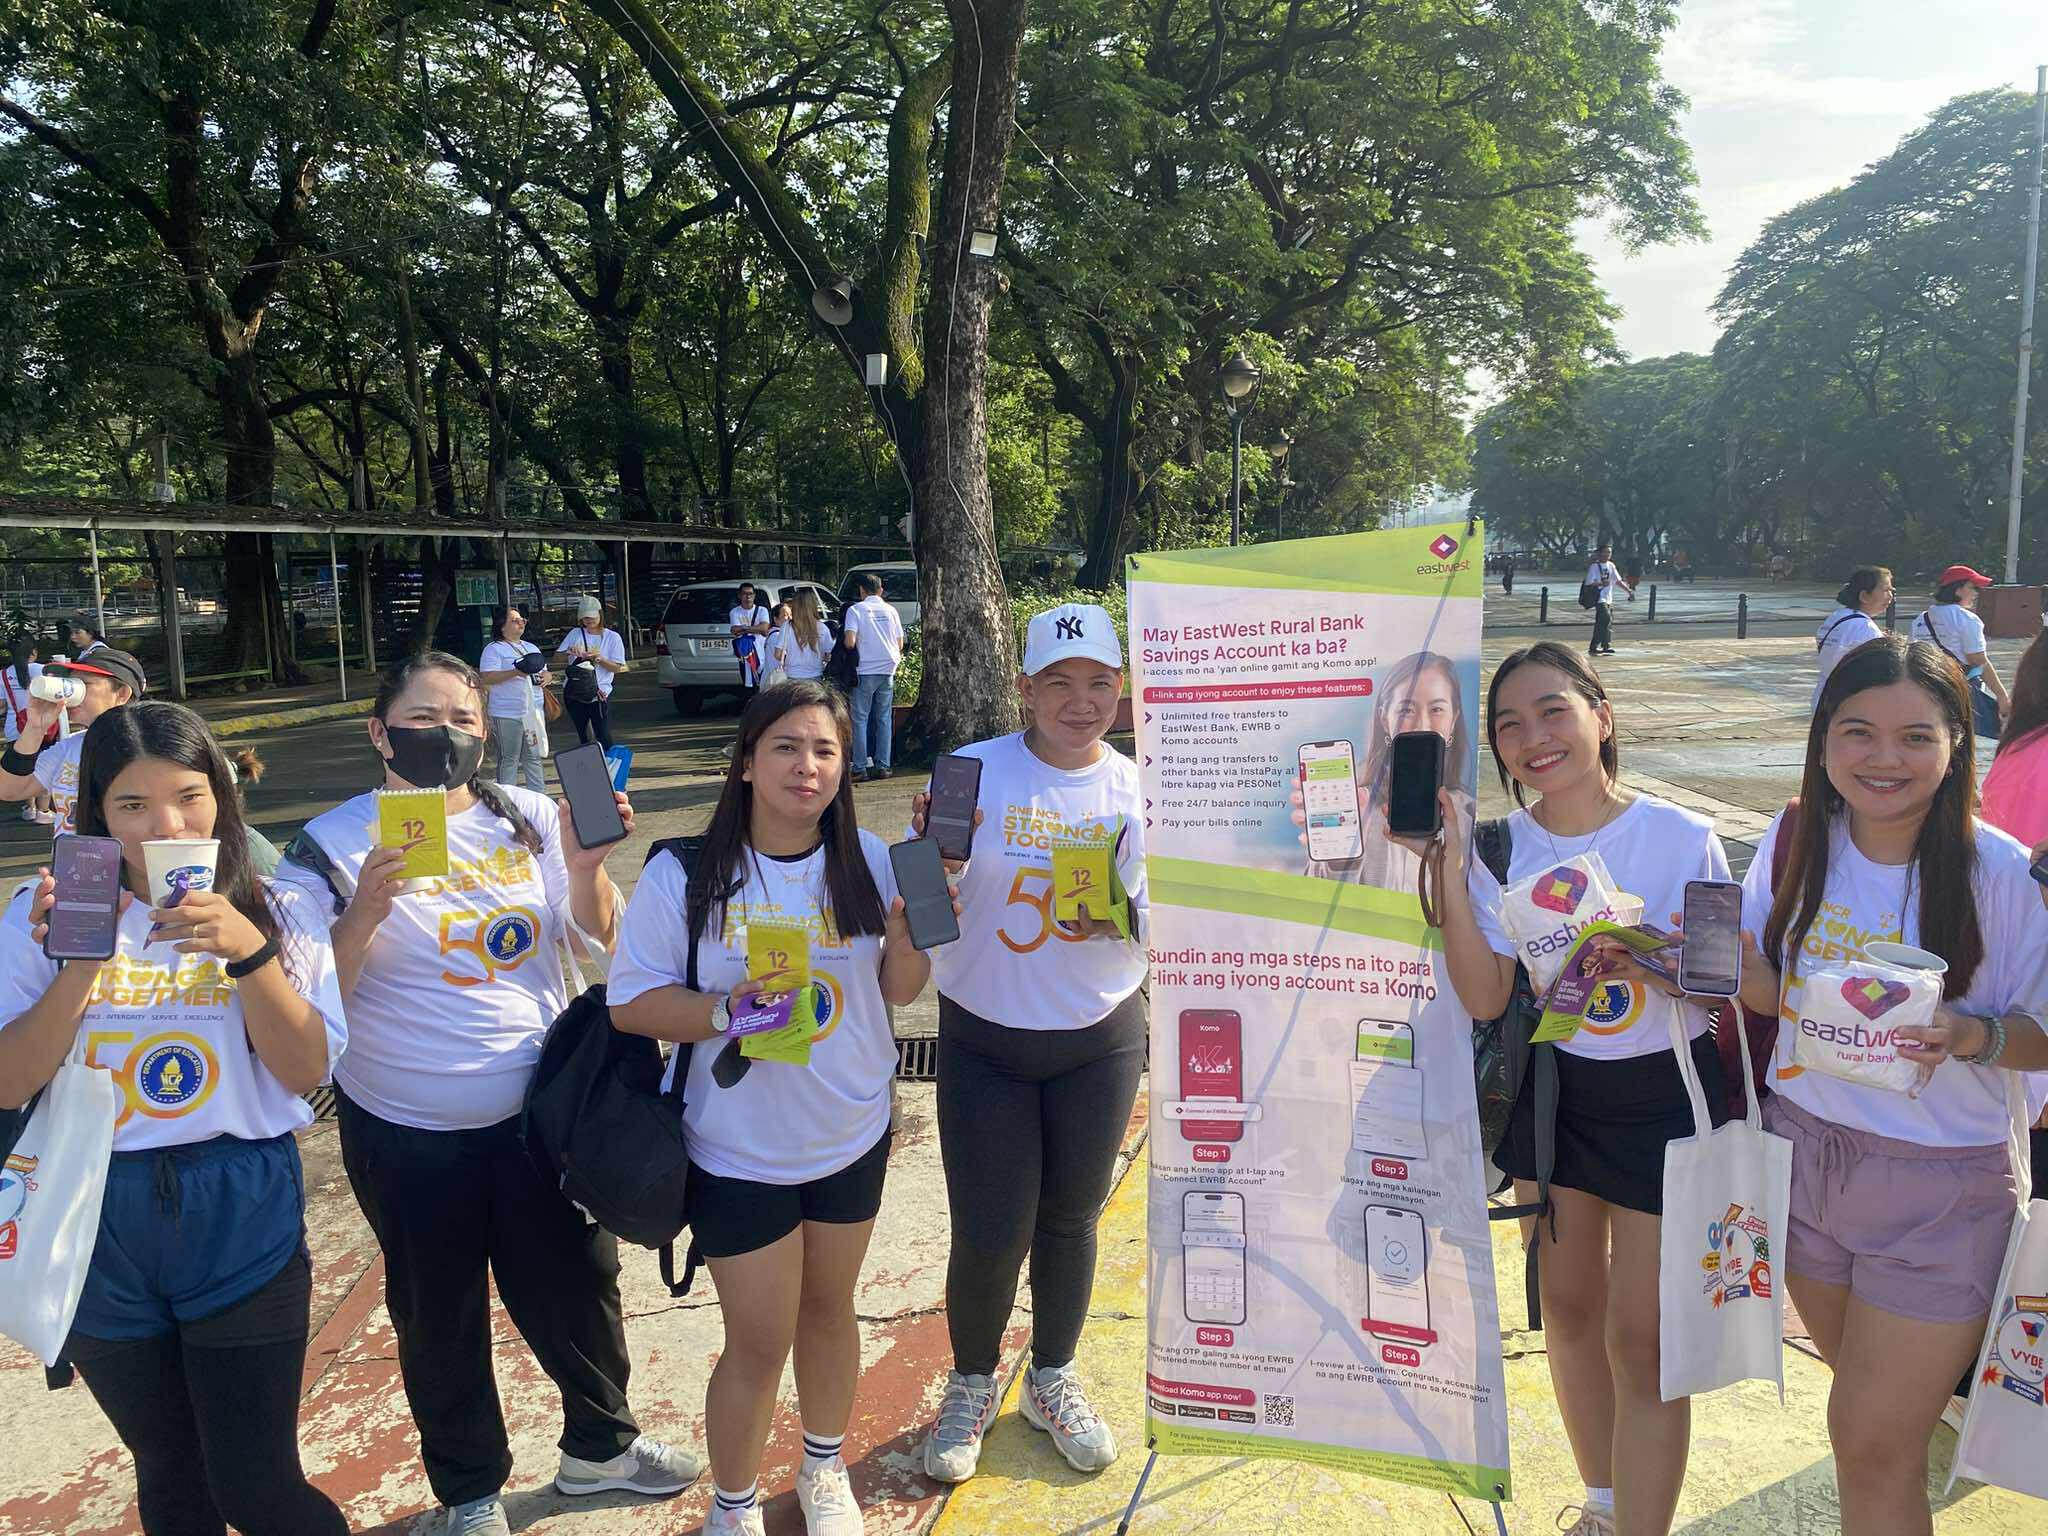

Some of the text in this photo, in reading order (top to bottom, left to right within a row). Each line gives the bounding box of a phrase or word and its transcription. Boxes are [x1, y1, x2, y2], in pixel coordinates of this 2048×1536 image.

[1416, 560, 1471, 575] eastwest
[1055, 616, 1084, 640] NY
[1143, 614, 1364, 644] May EastWest Rural Bank
[1143, 638, 1347, 665] Savings Account ka ba?
[1143, 668, 1183, 676] I-access
[1186, 667, 1200, 675] mo
[1203, 667, 1215, 675] na
[1240, 663, 1269, 673] online
[1271, 661, 1298, 672] gamit
[1301, 661, 1320, 670] ang
[1322, 659, 1351, 668] Komo
[1354, 657, 1377, 668] app!
[1152, 683, 1366, 700] I-link ang iyong account to enjoy these features:
[1161, 709, 1289, 721] Unlimited free transfers to
[1161, 724, 1207, 733] EastWest
[1210, 723, 1239, 733] Bank,
[1241, 722, 1271, 732] EWRB
[1161, 736, 1239, 745] Komo accounts
[1177, 754, 1279, 766] lang ang transfers to
[1161, 766, 1295, 777] other banks via InstaPay at
[1161, 779, 1281, 790] libre kapag via PESONet
[1161, 799, 1287, 810] Free 24/7 balance inquiry
[1008, 805, 1062, 820] ONE NCR
[401, 821, 426, 839] 12
[1162, 817, 1263, 828] Pay your bills online
[1071, 869, 1092, 886] 12
[1526, 904, 1618, 958] eastwes
[767, 951, 789, 969] 12
[1150, 948, 1431, 977] Sundin ang mga steps na ito para
[1152, 970, 1436, 1001] -link ang iyong account sa Komo
[1199, 1024, 1220, 1032] Komo
[142, 1047, 172, 1075] DEPARTMENT
[182, 1049, 202, 1076] EDUCATION
[1837, 1050, 1896, 1064] rural bank
[1196, 1148, 1227, 1159] Step 1
[1173, 1165, 1285, 1177] ang Komo app at ang
[1375, 1162, 1405, 1175] Step 2
[1199, 1175, 1226, 1184] EWRB
[1366, 1180, 1381, 1189] ang
[1383, 1181, 1400, 1191] mga
[1402, 1184, 1441, 1198] kailangan
[1199, 1331, 1231, 1343] Step 3
[1165, 1347, 1181, 1355] ang
[1182, 1348, 1200, 1356] OTP
[1202, 1350, 1228, 1359] galing
[1229, 1352, 1240, 1360] sa
[1242, 1353, 1265, 1363] iyong
[1267, 1355, 1294, 1364] EWRB
[1385, 1348, 1416, 1362] Step 4
[2011, 1348, 2045, 1371] VYBE
[1189, 1358, 1218, 1367] mobile
[1219, 1361, 1251, 1370] number
[1310, 1359, 1344, 1369] I-review
[1401, 1369, 1443, 1384] Congrats,
[1444, 1379, 1491, 1394] accessible
[1150, 1380, 1178, 1394] Download
[1180, 1387, 1206, 1397] Komo
[1206, 1391, 1221, 1400] app
[1328, 1372, 1345, 1380] ang
[1347, 1373, 1374, 1383] EWRB
[1376, 1377, 1411, 1387] account
[1430, 1385, 1440, 1393] sa
[1442, 1387, 1467, 1399] Komo
